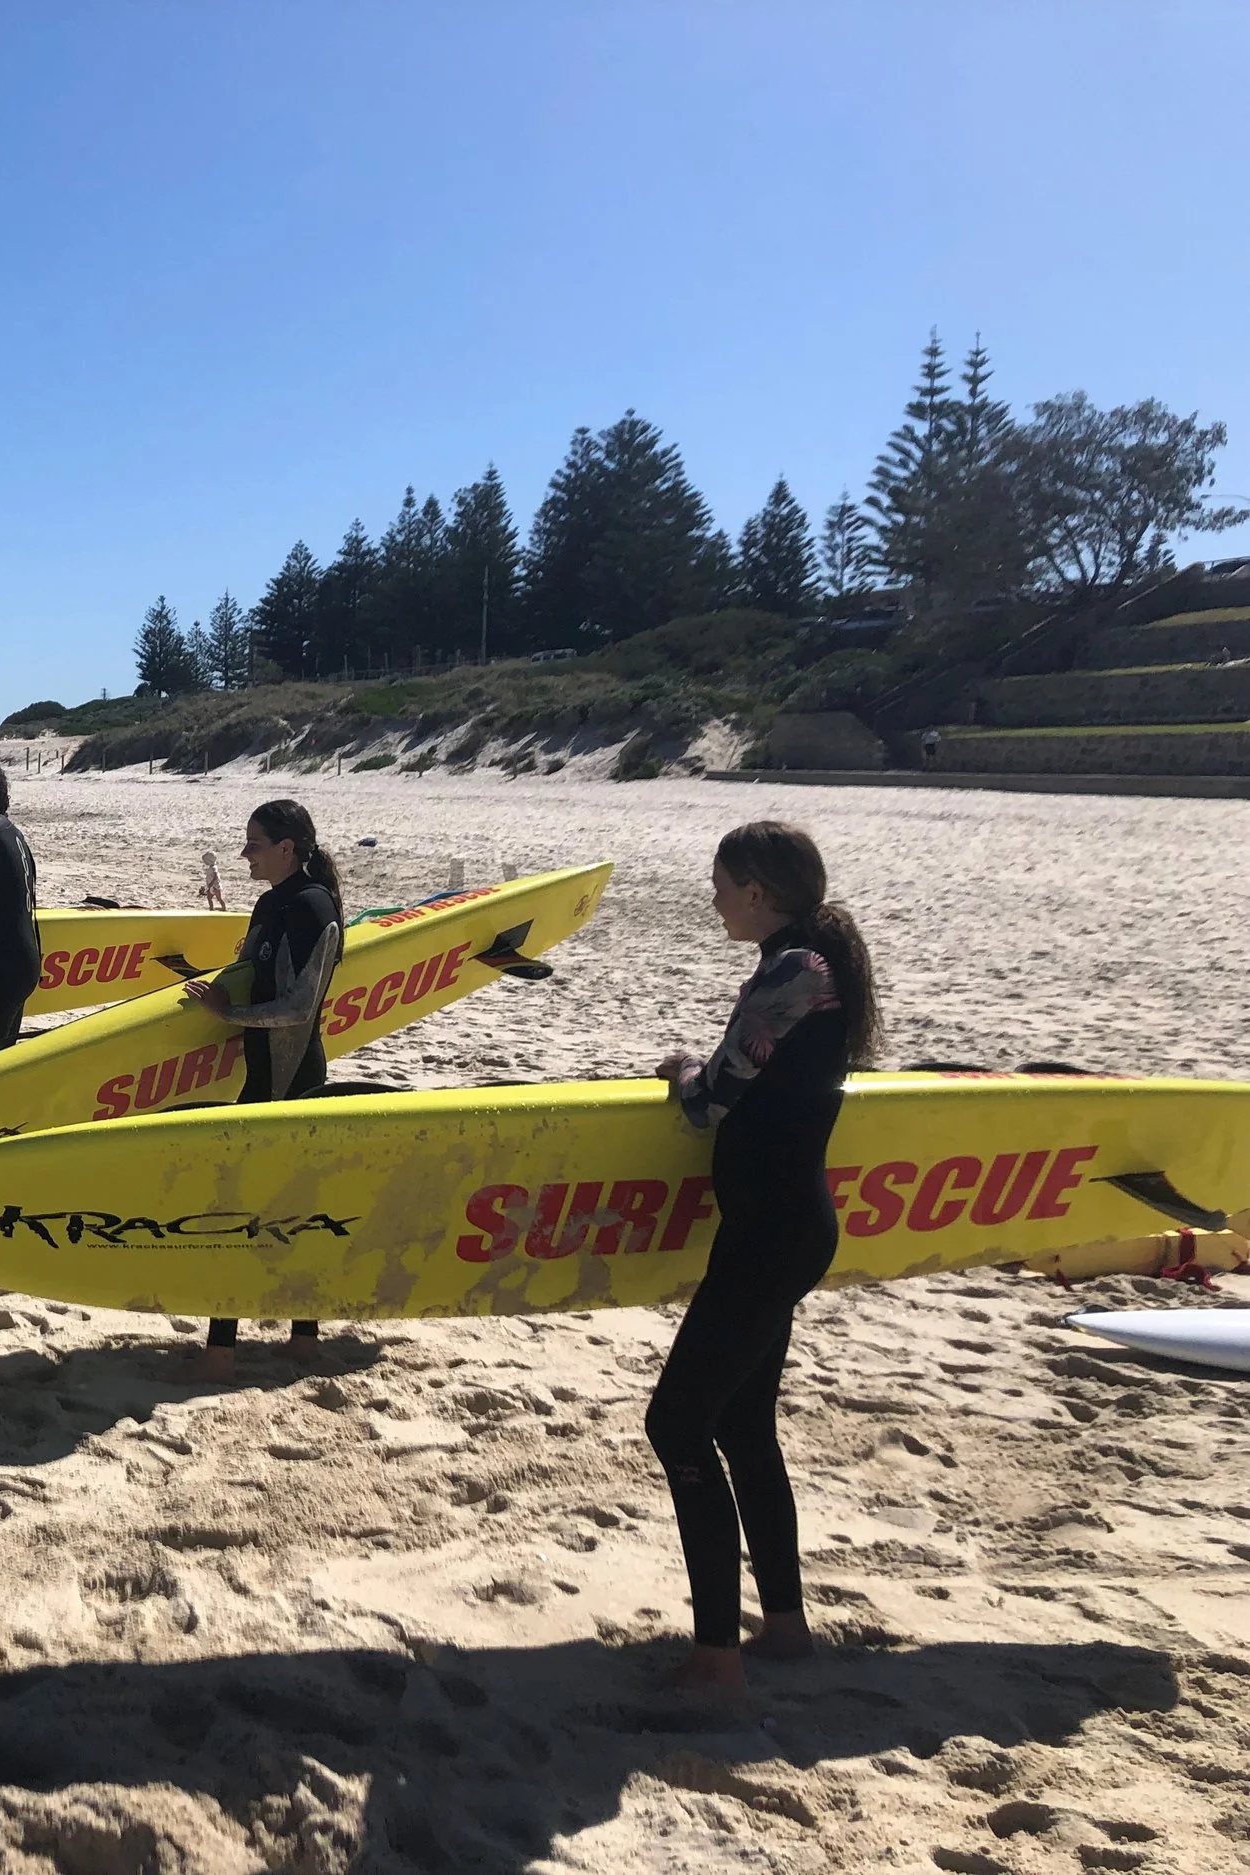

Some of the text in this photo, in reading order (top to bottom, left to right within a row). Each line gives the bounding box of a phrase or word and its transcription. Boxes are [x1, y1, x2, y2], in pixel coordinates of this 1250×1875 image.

[370, 908, 426, 928] SURF
[38, 942, 152, 989] SCUE
[92, 940, 472, 1121] SURF SCUE
[456, 1145, 1099, 1262] SURF SCUE
